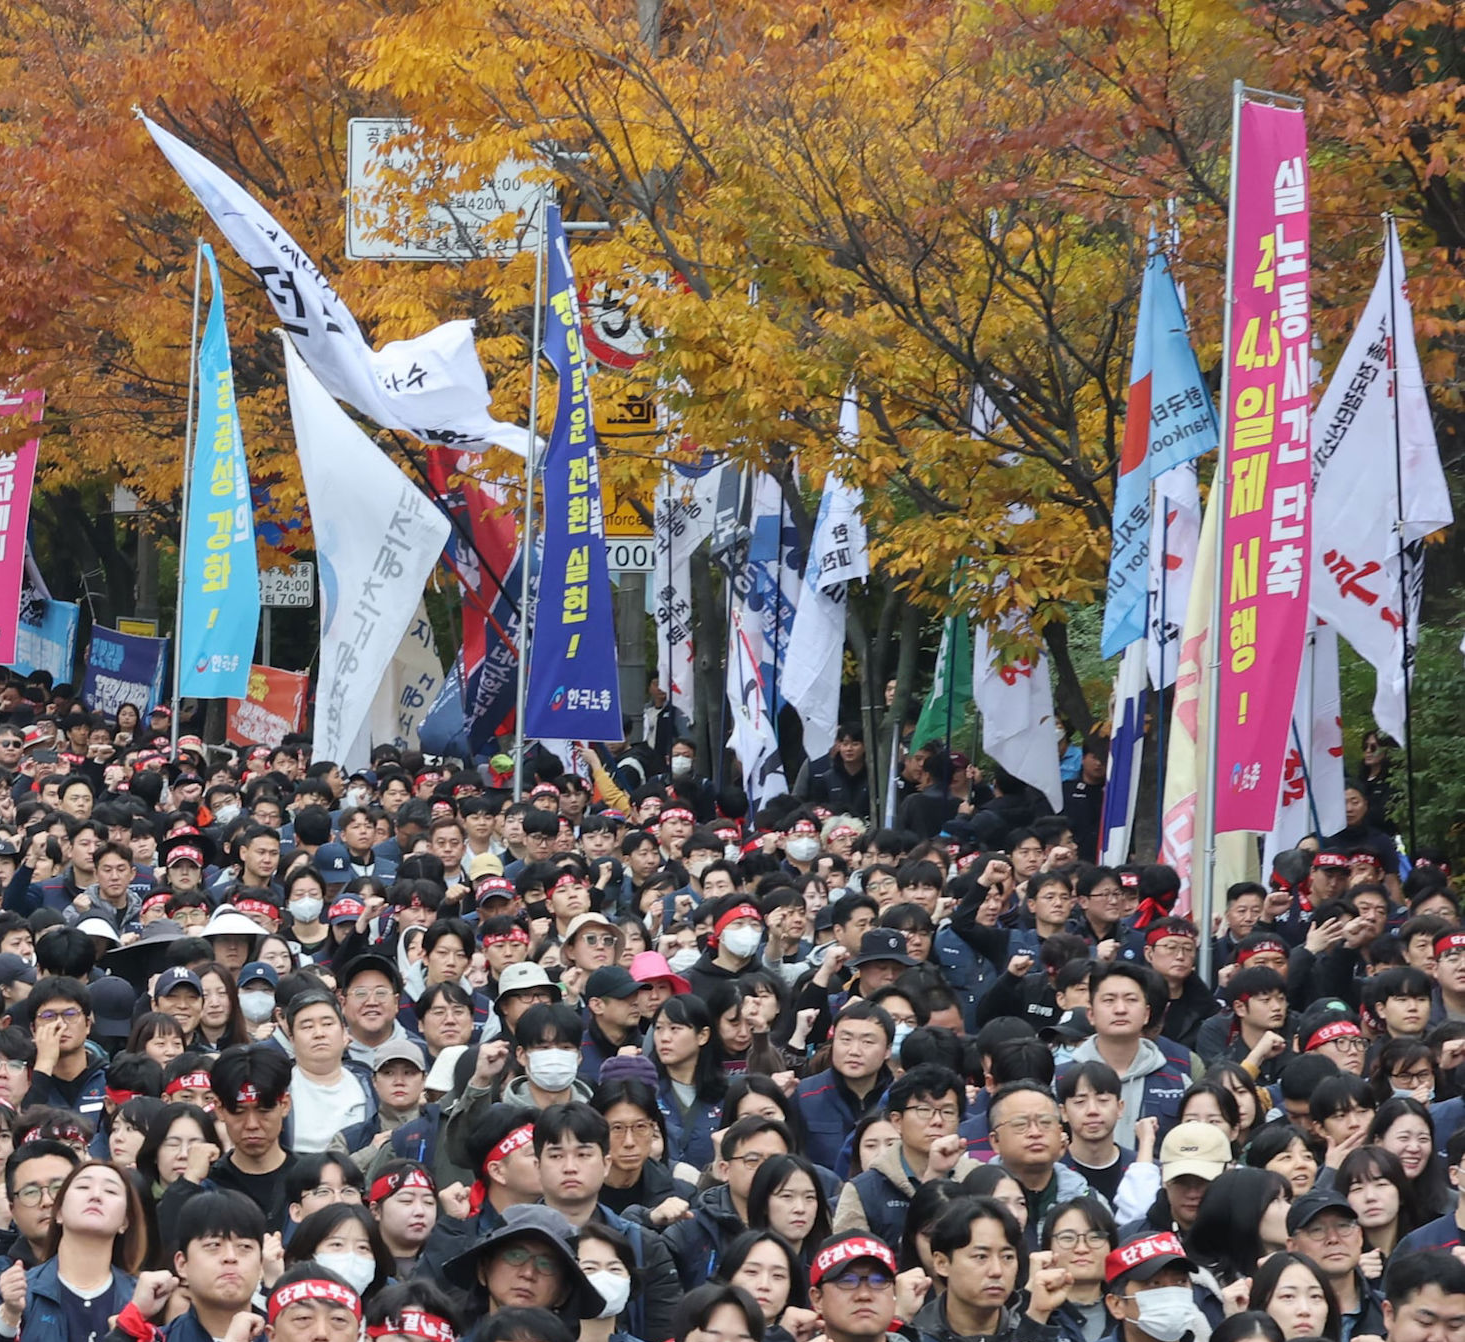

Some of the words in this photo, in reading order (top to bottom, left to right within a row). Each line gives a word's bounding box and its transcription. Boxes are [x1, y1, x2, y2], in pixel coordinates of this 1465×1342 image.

[1274, 156, 1309, 465] 실노동시간
[567, 460, 589, 536] 전환
[1266, 485, 1308, 600] 단축
[567, 687, 612, 711] 한국노총
